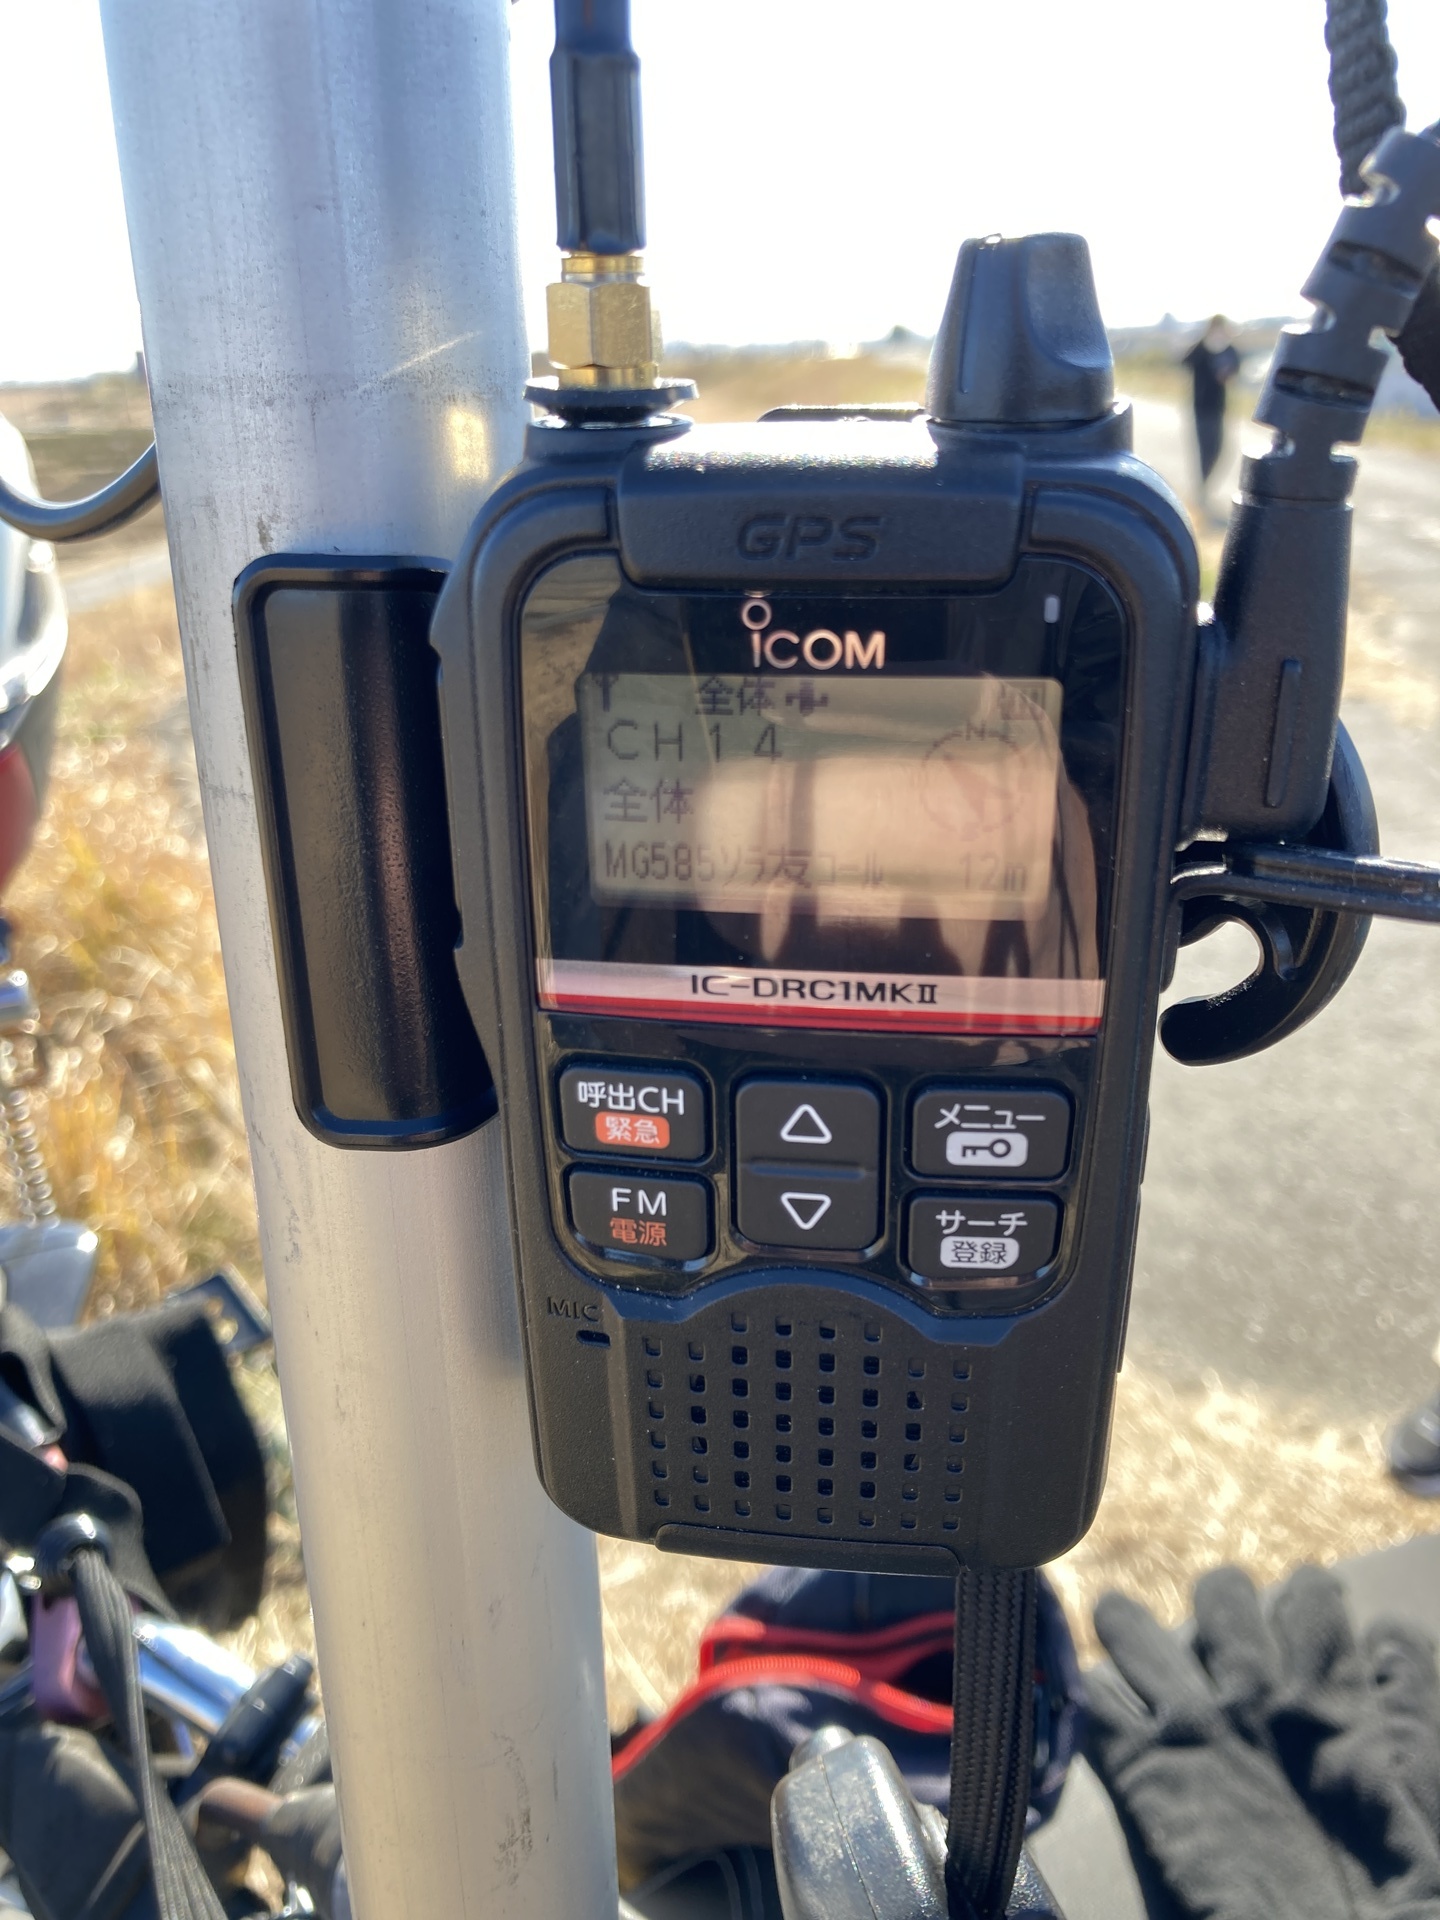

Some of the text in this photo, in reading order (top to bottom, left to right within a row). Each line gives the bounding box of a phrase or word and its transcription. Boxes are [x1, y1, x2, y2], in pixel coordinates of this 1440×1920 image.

[737, 515, 886, 563] GPS
[695, 676, 776, 716] 全体
[603, 776, 695, 824] 全体
[577, 1080, 685, 1116] 呼出CH
[604, 1115, 661, 1145] 緊急
[933, 1103, 1047, 1130] メニュー
[610, 1187, 668, 1217] FM
[609, 1217, 668, 1247] 電源
[935, 1209, 1028, 1237] サーチ
[950, 1240, 1008, 1265] 登録
[547, 1295, 600, 1323] MIC
